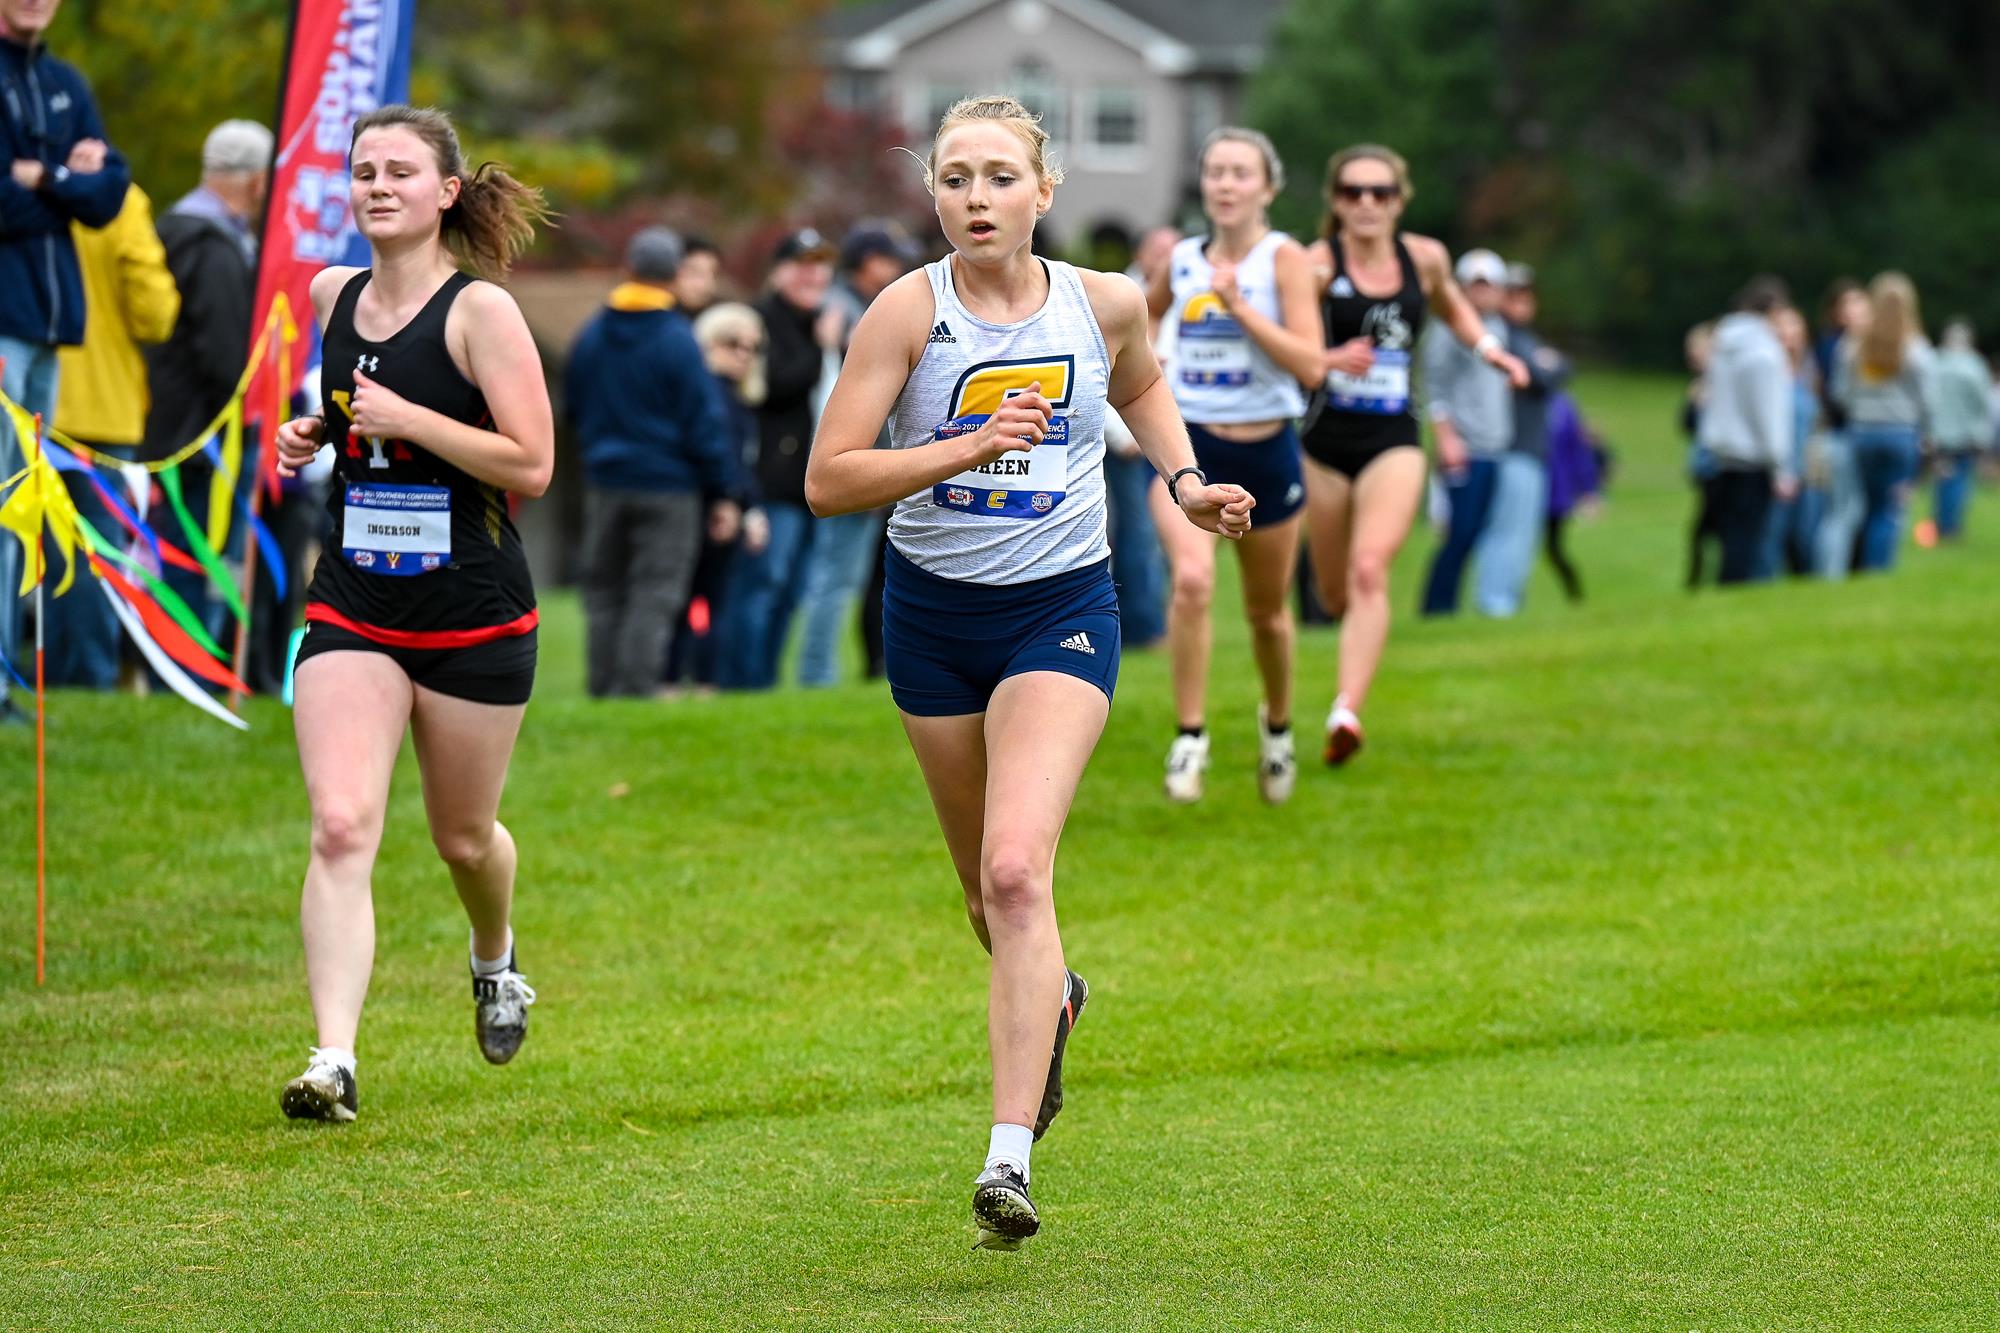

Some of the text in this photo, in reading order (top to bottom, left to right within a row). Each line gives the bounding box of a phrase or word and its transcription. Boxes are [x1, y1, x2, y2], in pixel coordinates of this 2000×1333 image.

[928, 334, 957, 343] didas
[962, 423, 979, 431] 2021
[987, 491, 1008, 508] C
[367, 523, 421, 537] INGERSON
[1060, 641, 1095, 654] adidas
